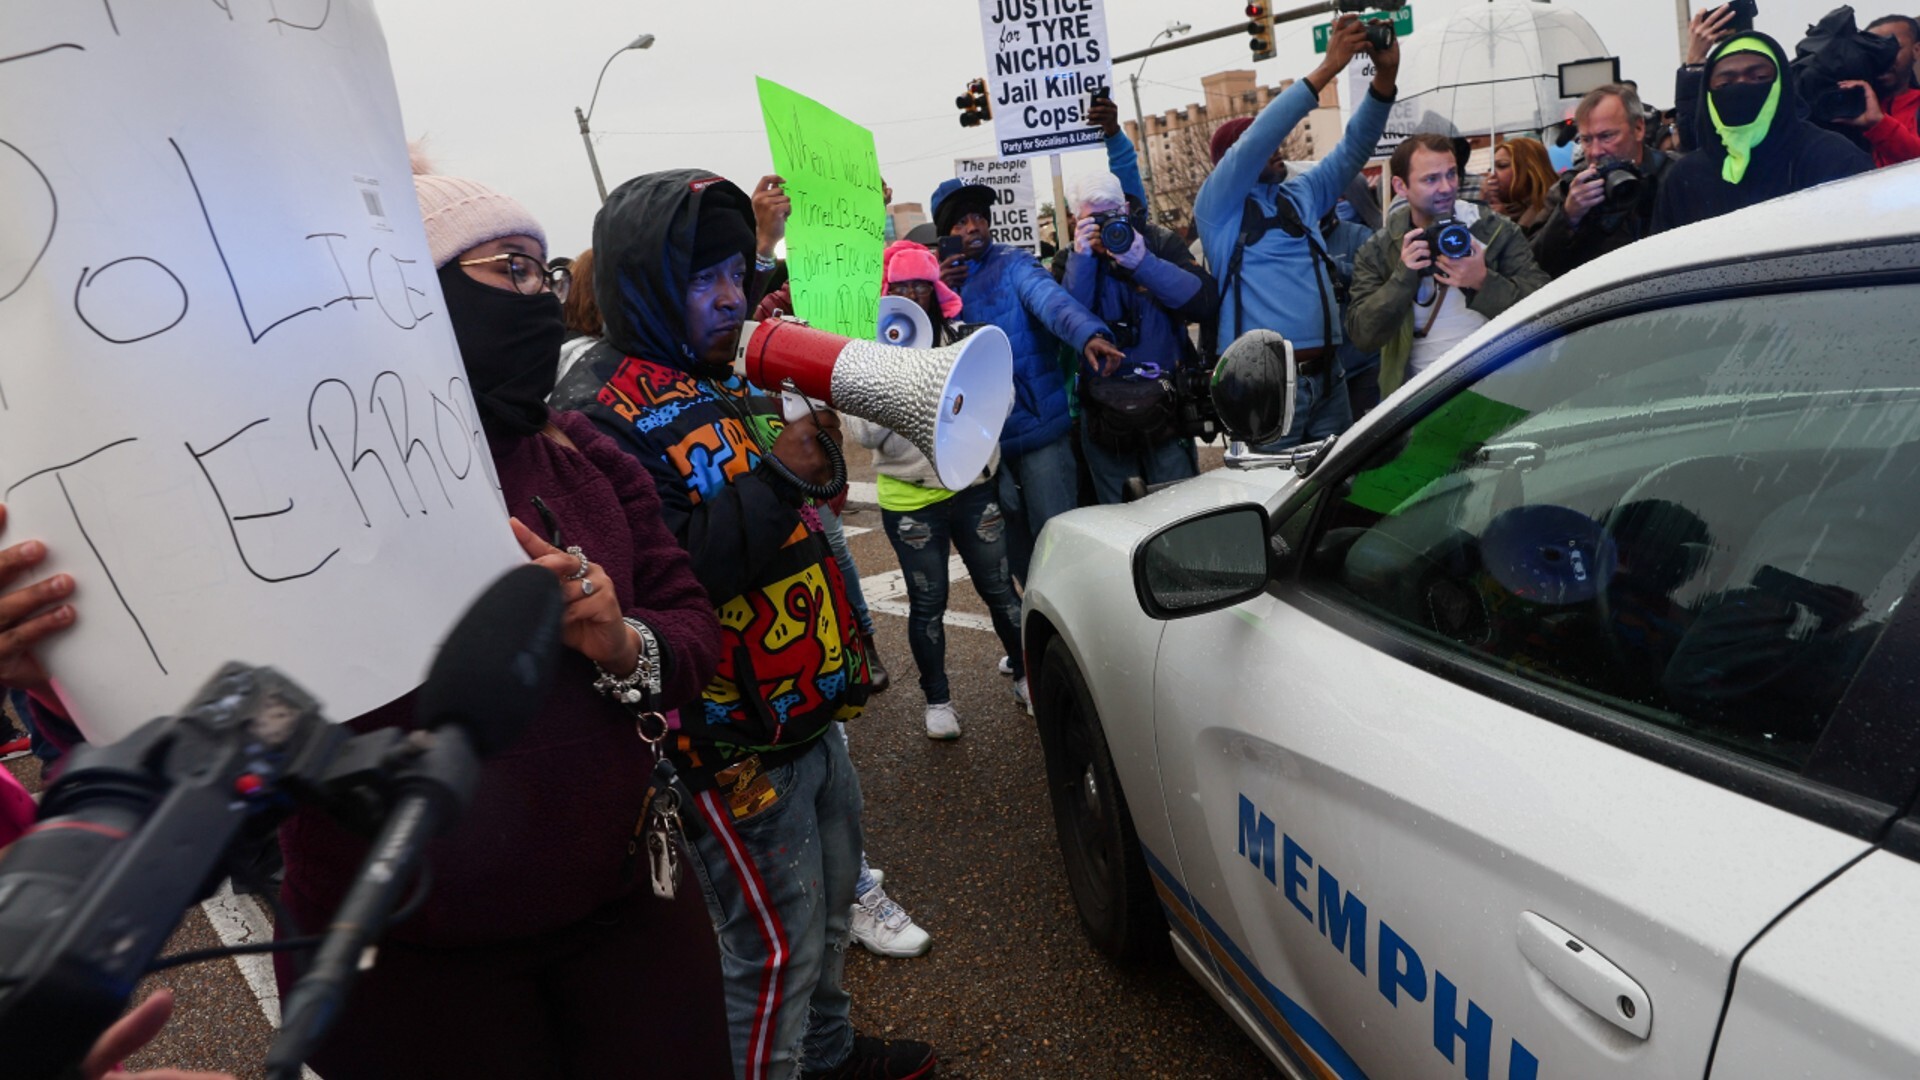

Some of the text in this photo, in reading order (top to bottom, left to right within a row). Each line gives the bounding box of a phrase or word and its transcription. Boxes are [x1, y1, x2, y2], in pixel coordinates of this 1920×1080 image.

[998, 13, 1091, 52] for TYRE
[1314, 28, 1323, 41] N
[995, 39, 1101, 77] NICHOLS
[997, 71, 1106, 106] Jail Killer
[1023, 98, 1086, 131] Cops!
[1003, 129, 1105, 153] Party for Socialism & Liberati
[963, 159, 1027, 173] The people
[972, 172, 1021, 186] demand:
[993, 208, 1029, 226] LICE
[990, 226, 1034, 243] RROR
